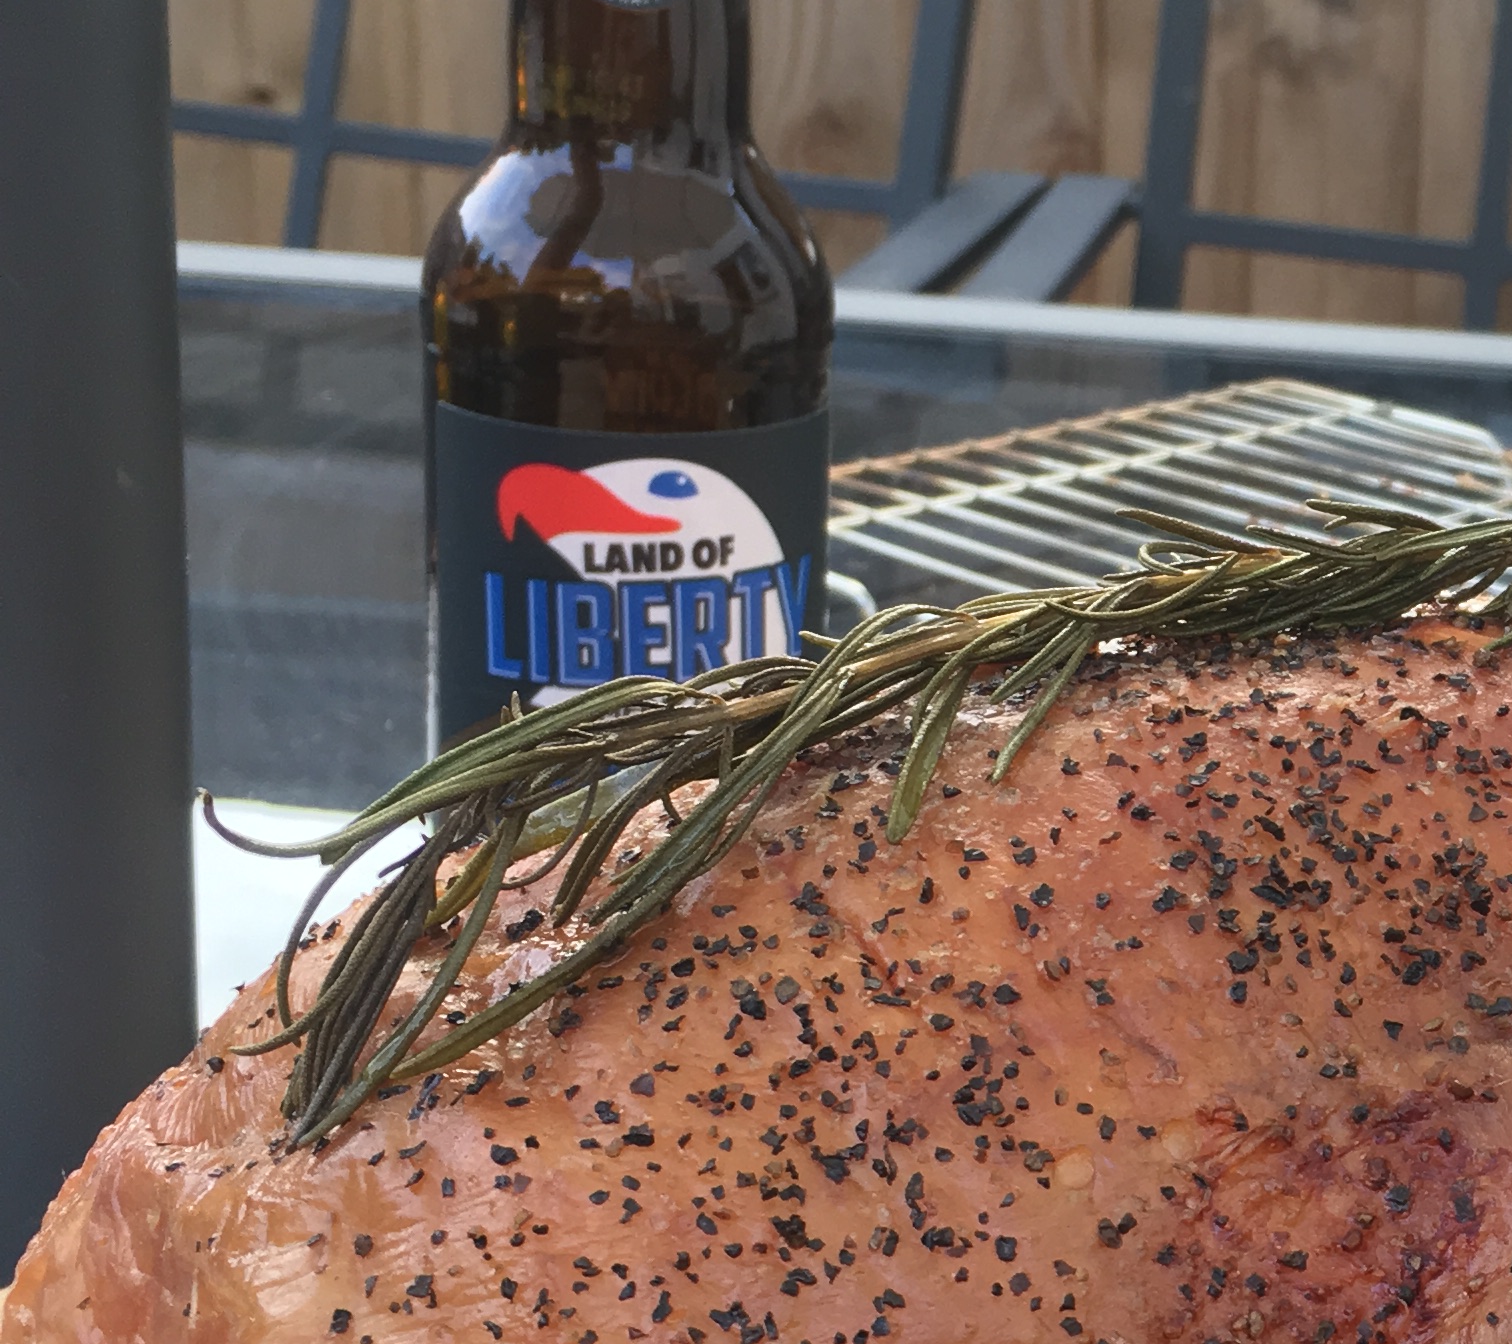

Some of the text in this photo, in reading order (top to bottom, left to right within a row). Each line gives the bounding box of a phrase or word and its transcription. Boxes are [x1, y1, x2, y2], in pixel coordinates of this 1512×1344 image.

[584, 534, 735, 573] LAND OF
[485, 553, 812, 687] LIBERTY
